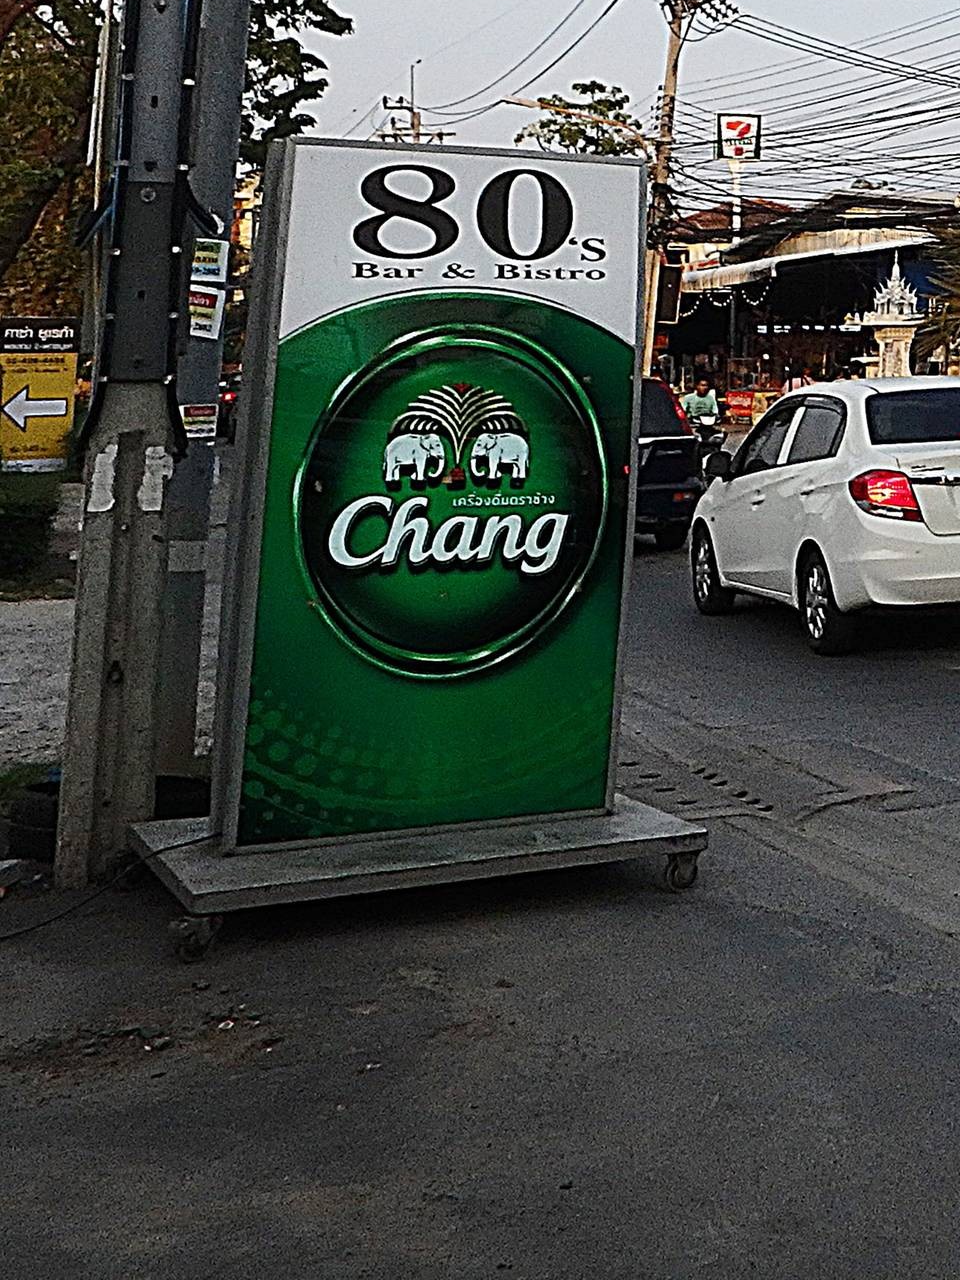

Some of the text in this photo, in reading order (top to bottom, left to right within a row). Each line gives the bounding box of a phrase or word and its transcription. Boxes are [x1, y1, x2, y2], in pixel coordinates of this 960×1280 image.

[351, 262, 606, 280] Bar & Bistro
[452, 490, 556, 507] เครื่องดื่มตราช้าง
[327, 493, 571, 576] Chang
